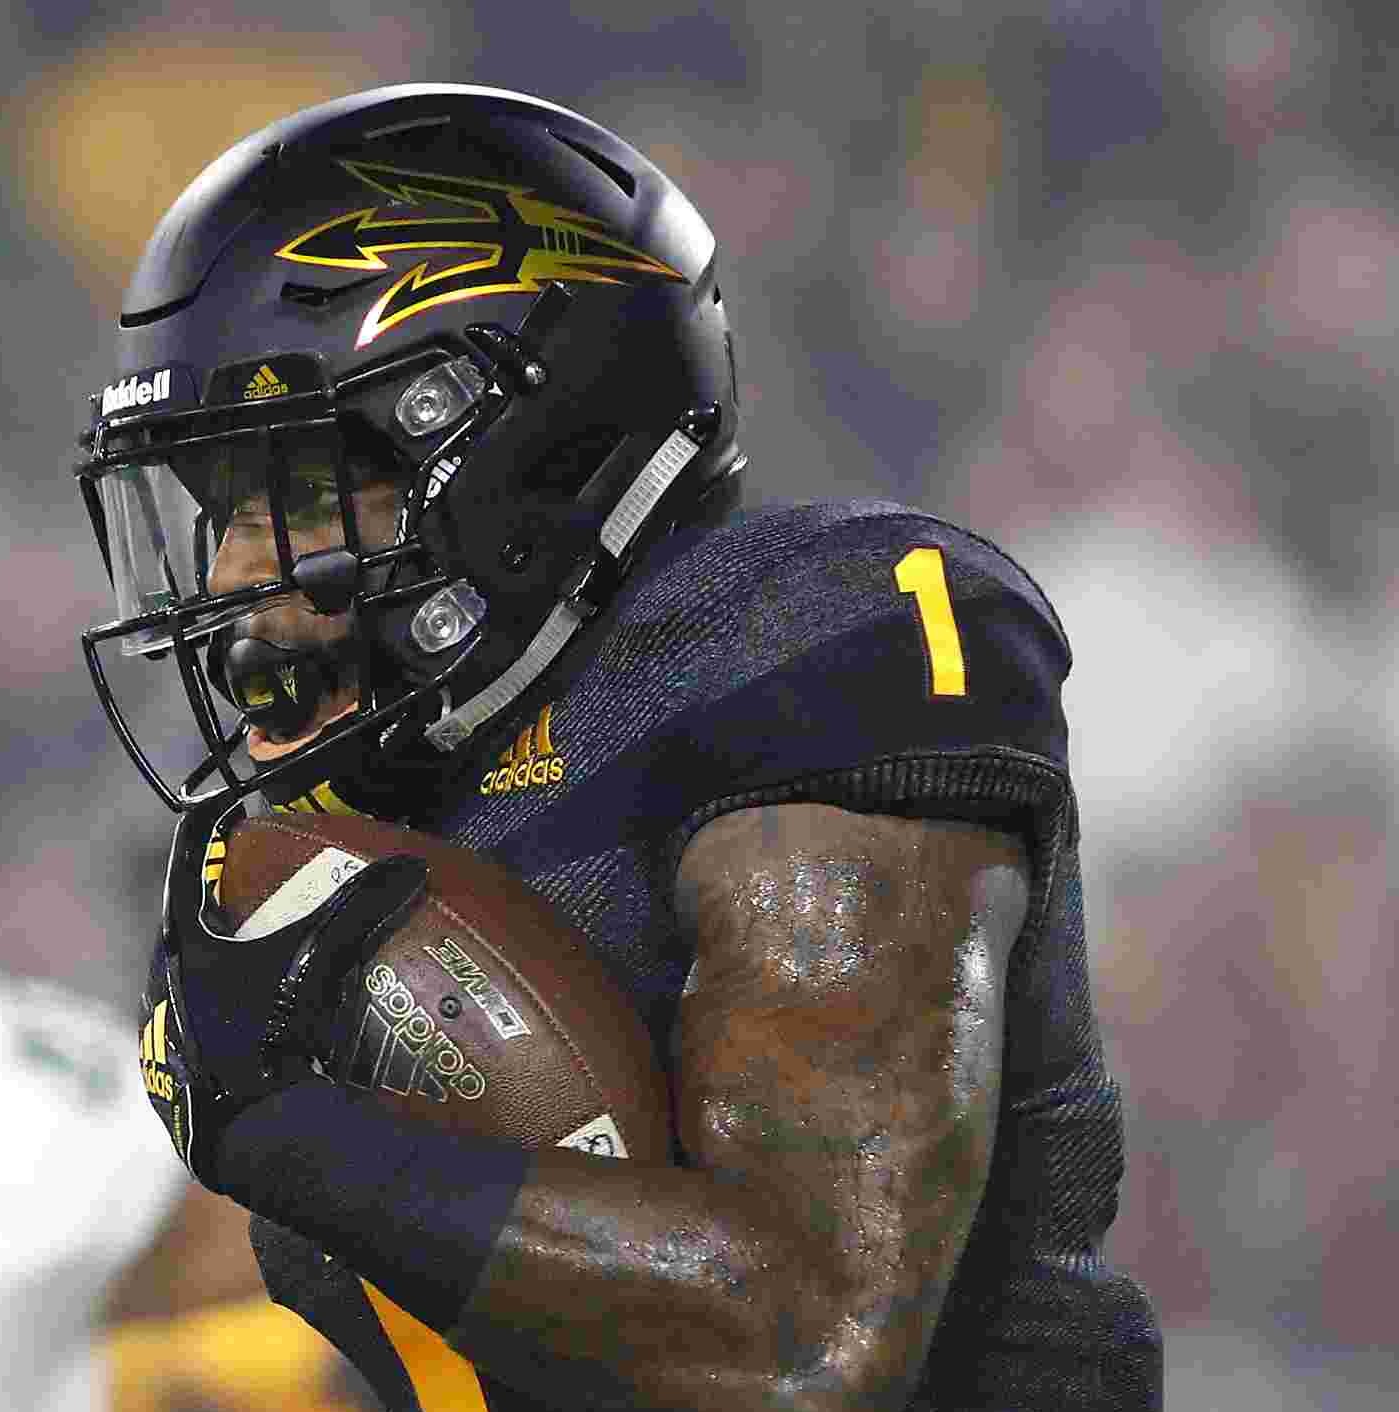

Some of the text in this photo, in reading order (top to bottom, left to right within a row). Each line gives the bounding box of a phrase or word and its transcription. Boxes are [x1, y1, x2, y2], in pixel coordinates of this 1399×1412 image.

[243, 382, 289, 400] adidas
[893, 547, 967, 697] 1
[480, 757, 565, 795] adidas
[365, 964, 486, 1100] adidas
